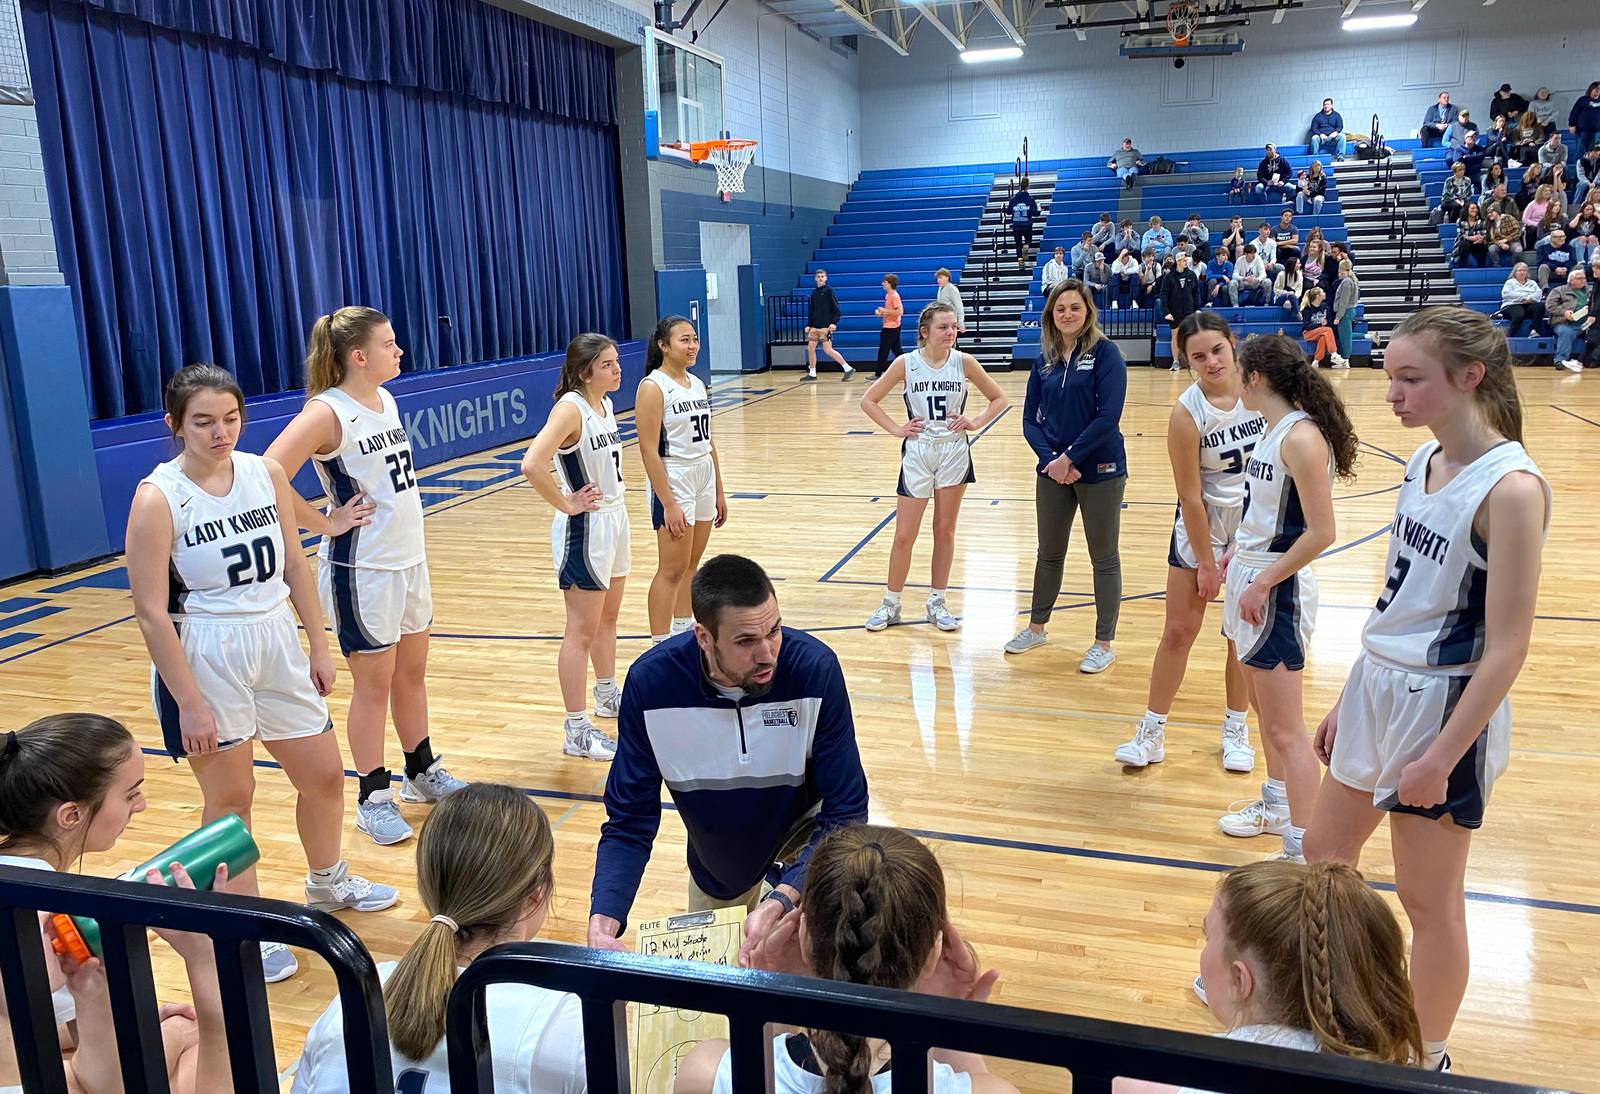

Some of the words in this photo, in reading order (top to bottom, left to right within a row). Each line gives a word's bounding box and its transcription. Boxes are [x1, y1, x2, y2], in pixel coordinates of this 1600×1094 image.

[911, 381, 930, 393] LADY
[931, 380, 962, 393] KNIGHTS
[404, 388, 527, 449] KNIGHTS
[672, 401, 693, 415] LADY
[926, 395, 947, 421] 15
[690, 413, 710, 443] 30
[1229, 416, 1268, 442] KNIGH
[358, 432, 388, 456] LADY
[384, 449, 415, 494] 22
[184, 519, 227, 548] LADY
[220, 535, 276, 588] 20
[639, 920, 661, 931] ELITE
